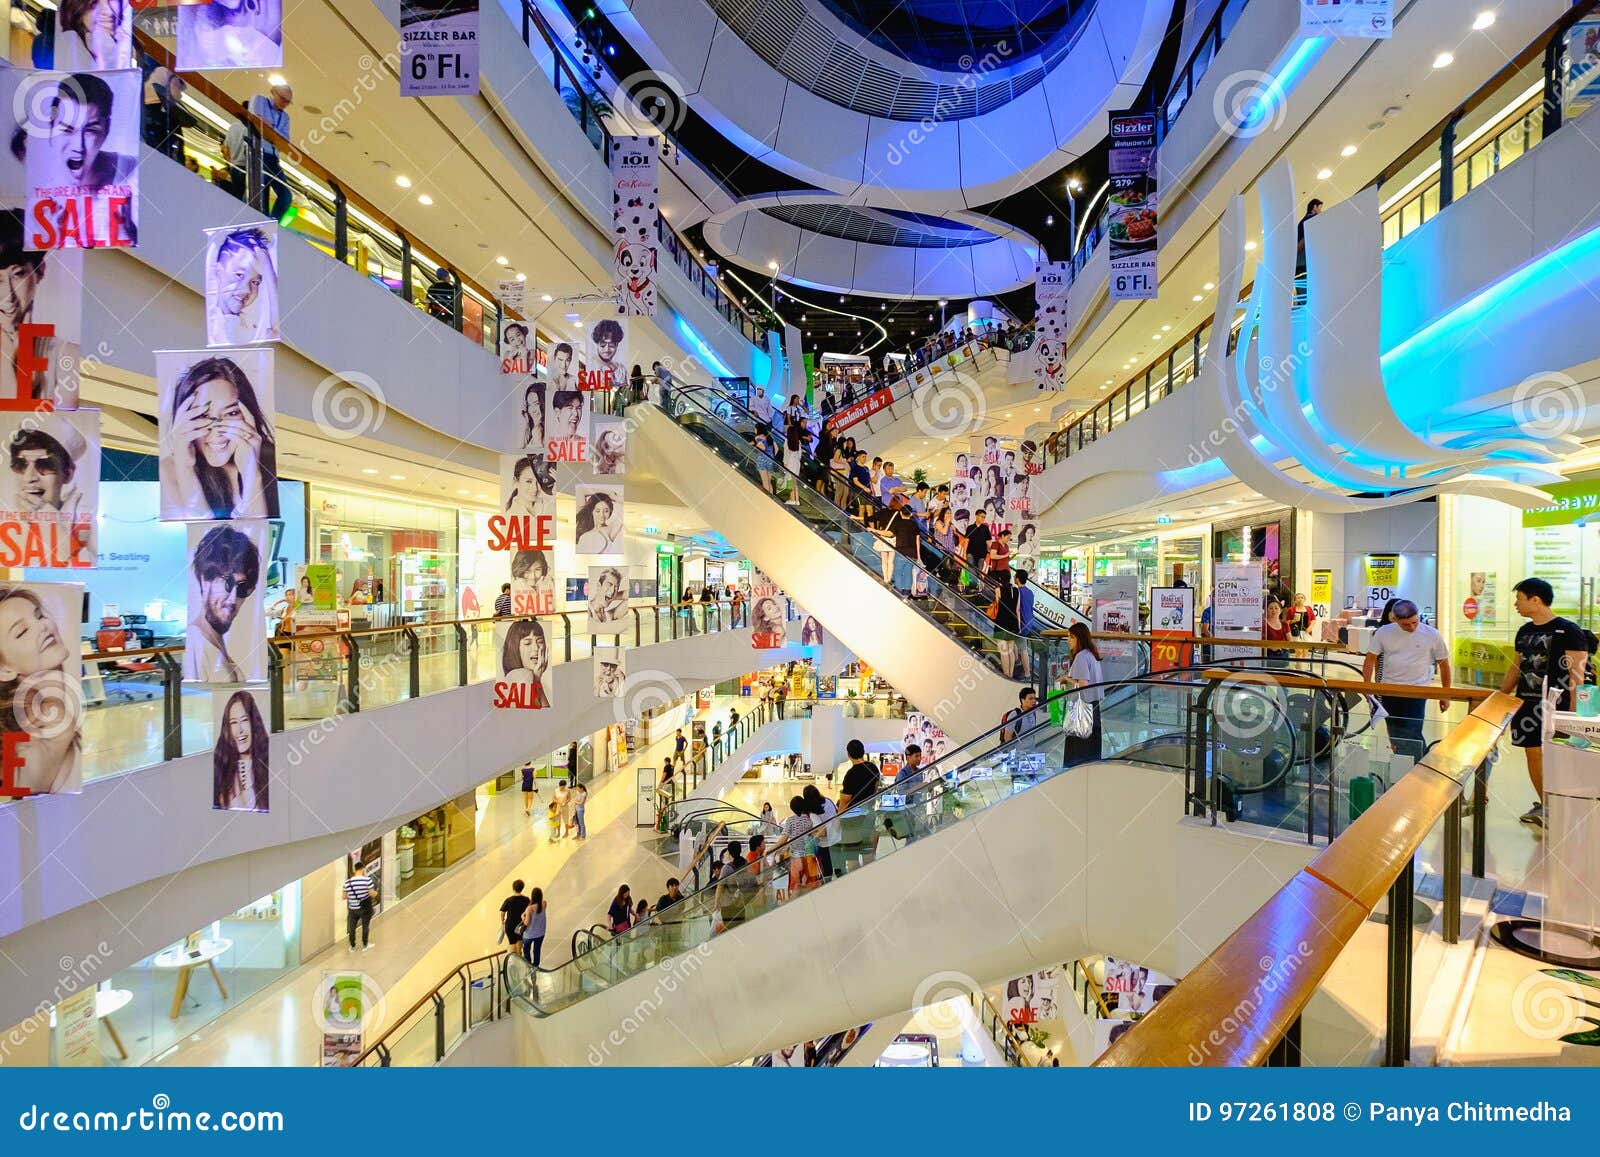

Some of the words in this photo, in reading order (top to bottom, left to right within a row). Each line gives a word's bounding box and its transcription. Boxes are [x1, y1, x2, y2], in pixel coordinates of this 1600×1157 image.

[403, 32, 449, 41] SIZZLER
[452, 32, 476, 41] BAR
[412, 53, 435, 80] 6th
[1114, 122, 1153, 133] Sizzler
[623, 156, 649, 165] 101
[33, 197, 132, 249] SALE
[503, 358, 533, 374] SALE
[577, 369, 614, 391] SALE
[546, 440, 587, 462] SALE
[1025, 463, 1043, 476] SALE
[1010, 499, 1031, 511] SALE
[488, 514, 553, 552] SALE
[0, 521, 92, 567] SALE
[110, 552, 150, 563] Seating
[1218, 582, 1238, 590] CPN
[514, 592, 555, 615] SALE
[751, 631, 782, 649] SALE
[1156, 644, 1177, 662] 70
[494, 681, 543, 710] SALE
[1105, 975, 1138, 993] SALE
[1009, 1006, 1039, 1024] SALE
